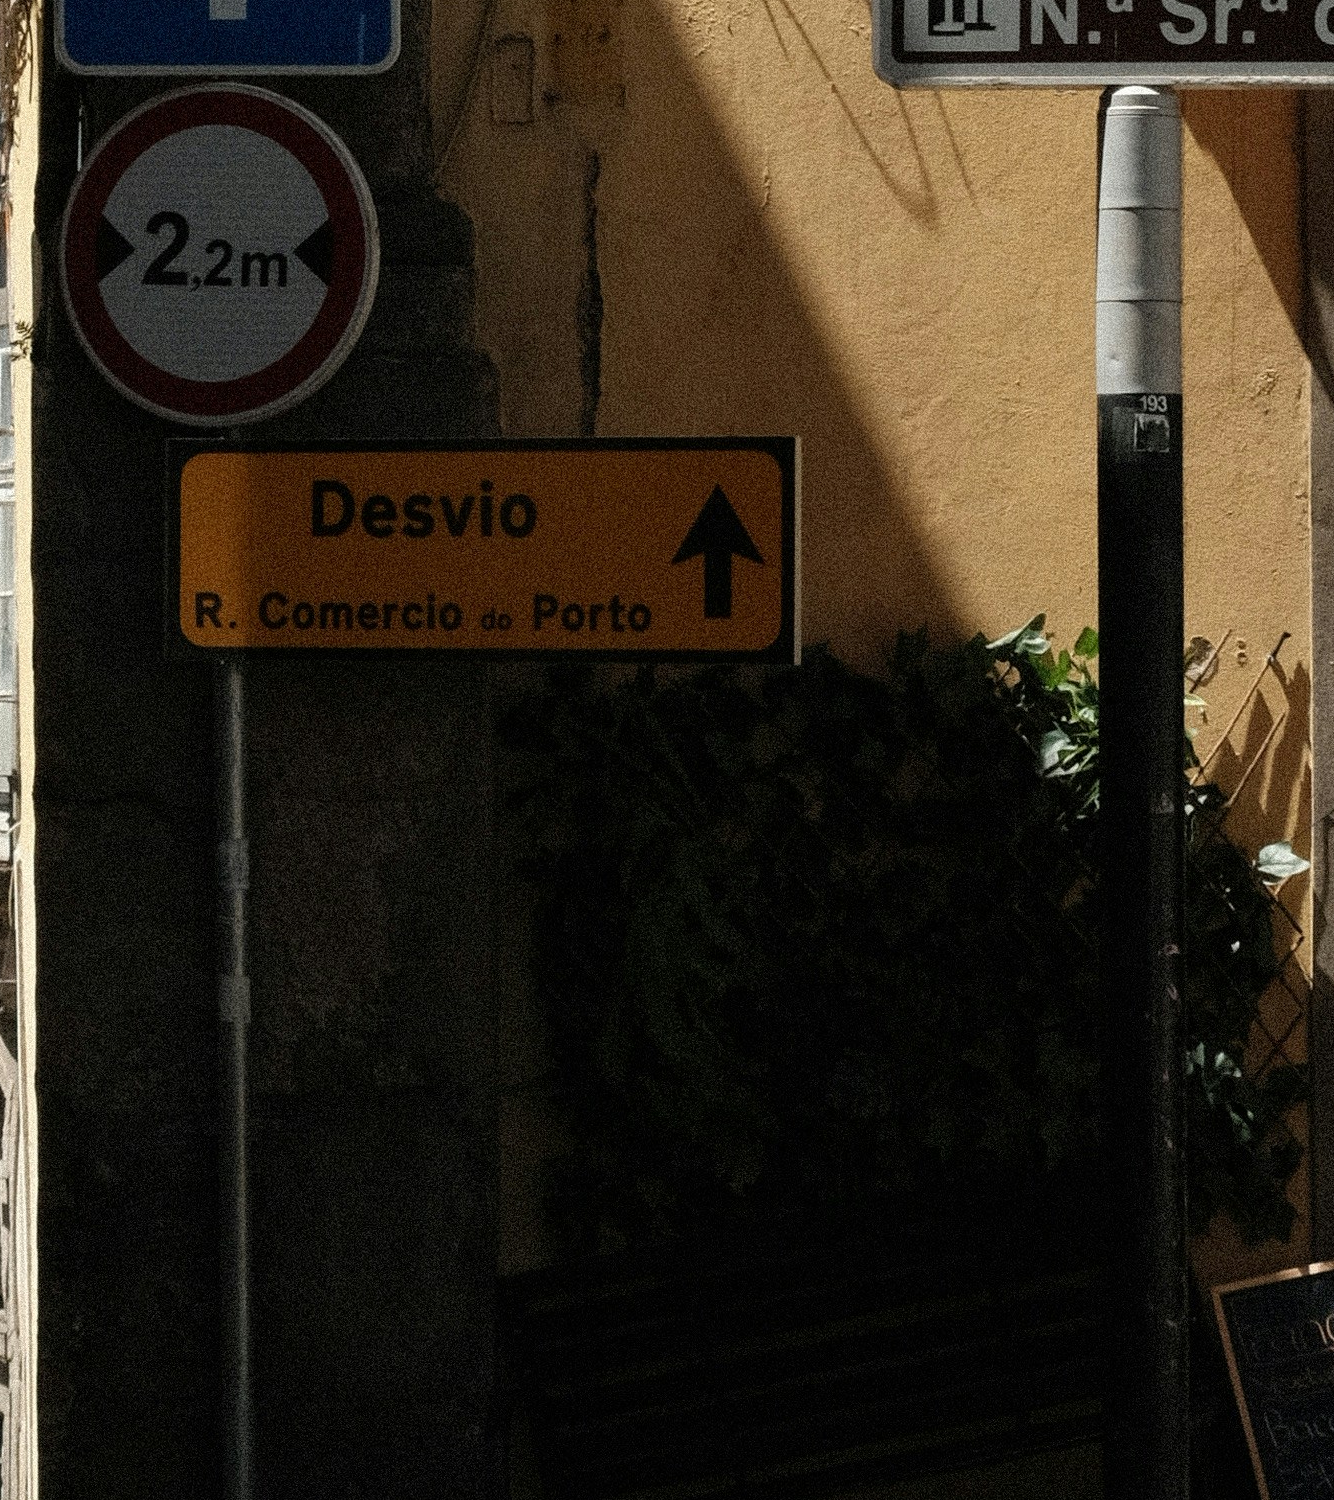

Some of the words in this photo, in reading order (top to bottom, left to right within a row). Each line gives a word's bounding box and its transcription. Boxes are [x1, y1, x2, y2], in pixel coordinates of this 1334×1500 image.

[311, 480, 537, 538] Desvio
[196, 592, 237, 628] R.
[259, 592, 462, 631] Comercio
[481, 609, 512, 630] do
[534, 594, 651, 632] Porto
